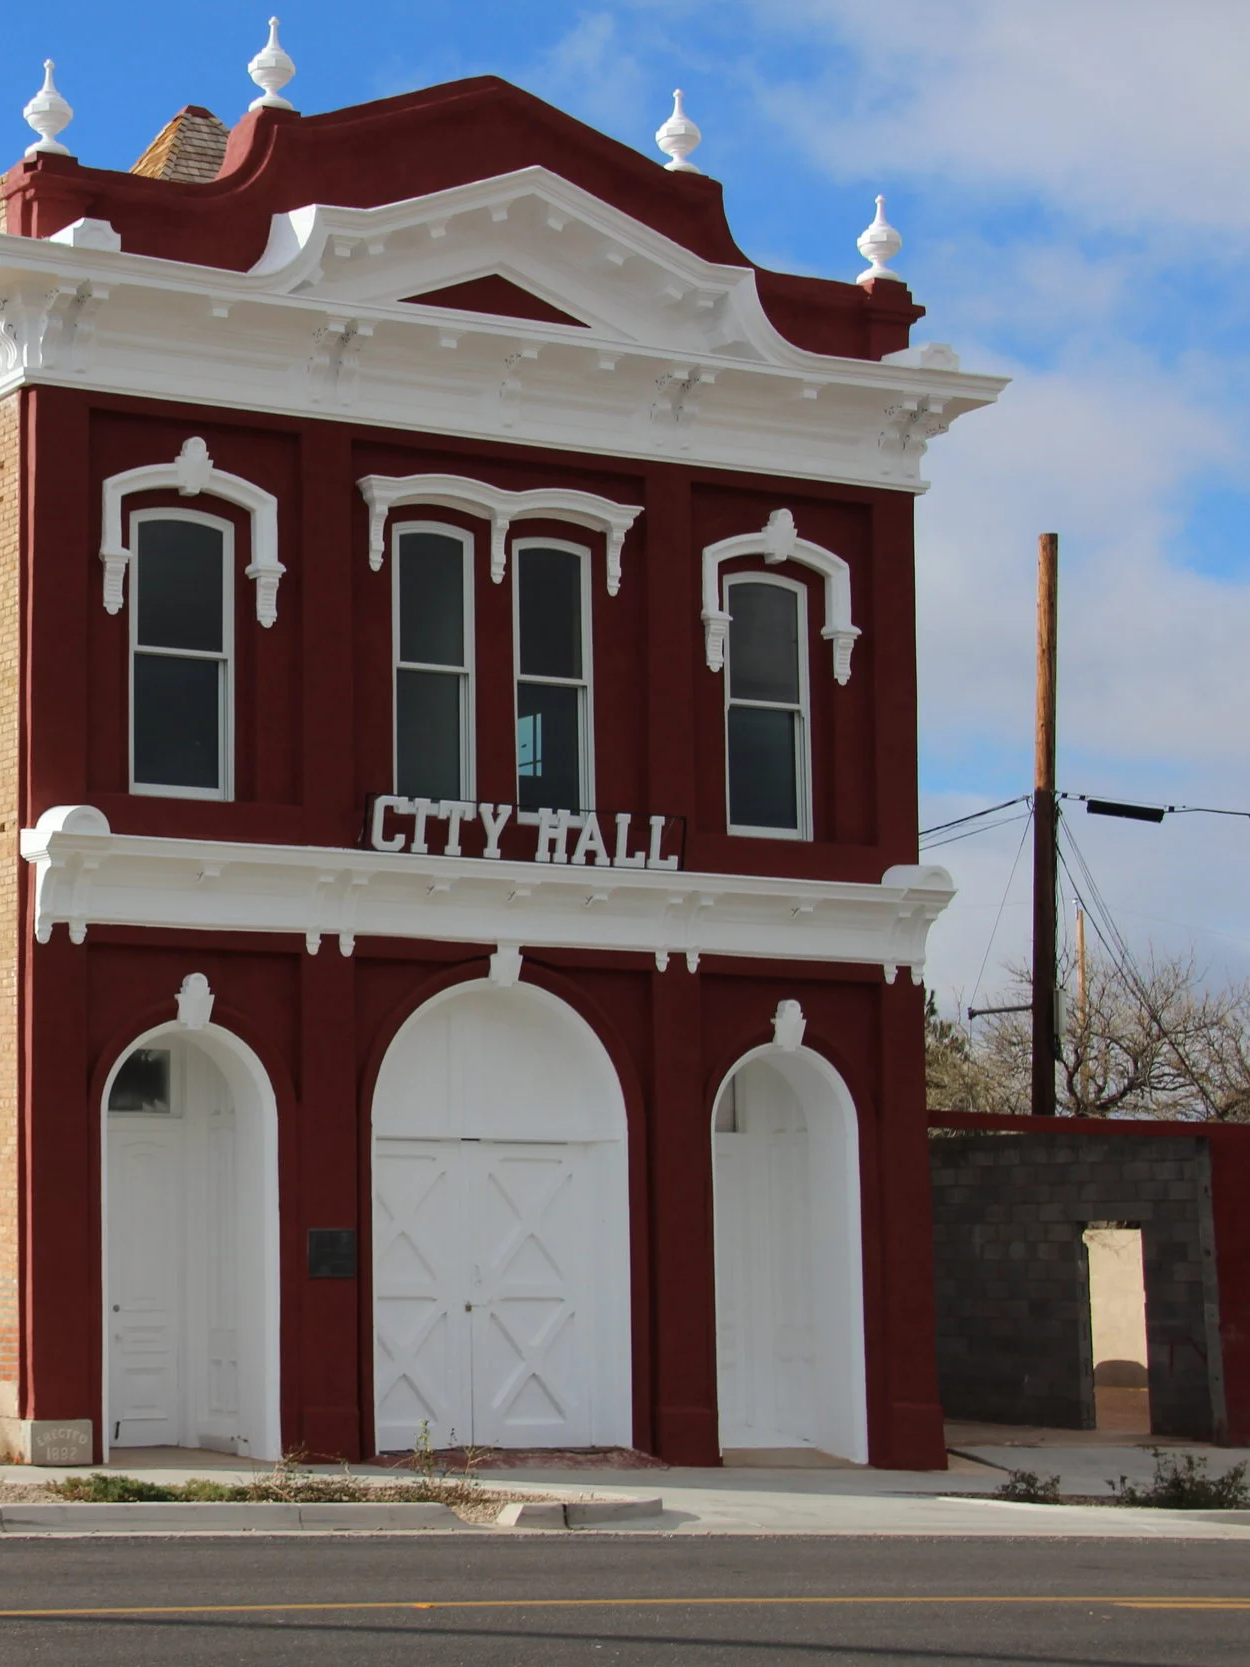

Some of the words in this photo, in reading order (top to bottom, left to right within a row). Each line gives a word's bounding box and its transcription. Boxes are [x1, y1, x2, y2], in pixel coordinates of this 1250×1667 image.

[372, 795, 512, 859] CITY
[535, 808, 678, 871] HALL
[35, 1428, 88, 1446] ERECTED
